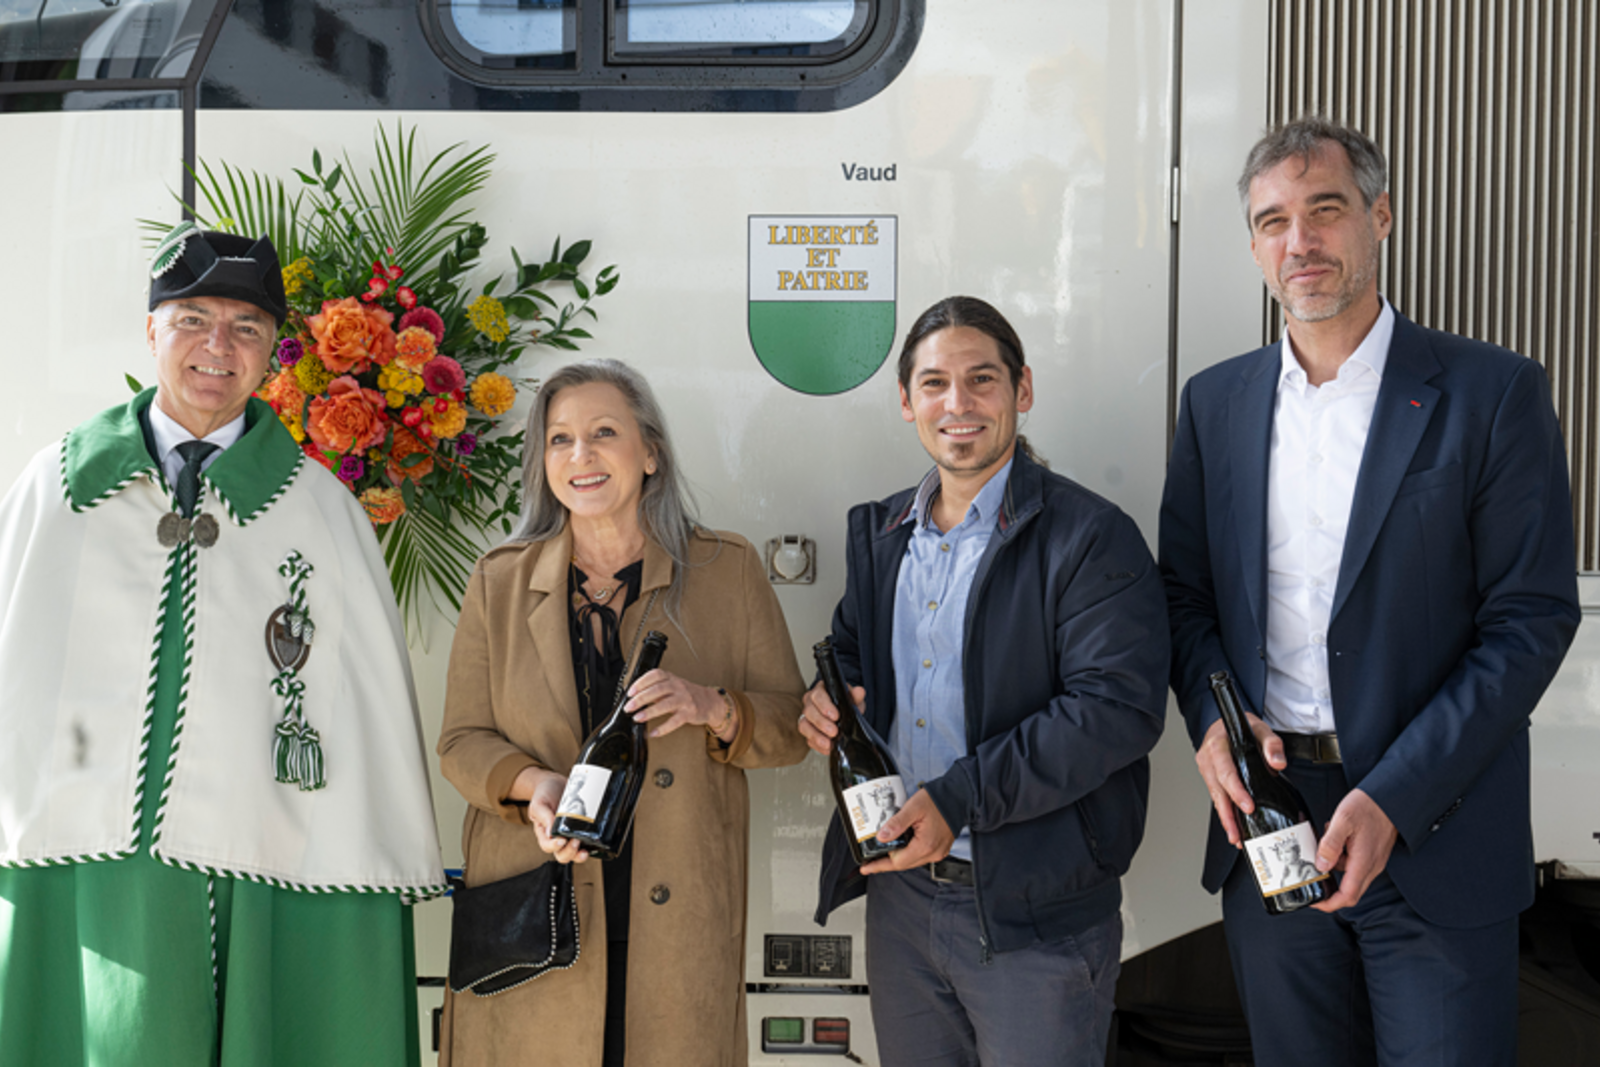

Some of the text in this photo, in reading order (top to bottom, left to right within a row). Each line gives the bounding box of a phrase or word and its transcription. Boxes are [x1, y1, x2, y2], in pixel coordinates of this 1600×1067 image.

[841, 162, 897, 181] Vaud
[767, 219, 879, 245] LIBERTÉ
[805, 248, 841, 268] ET
[777, 270, 869, 291] PATRIE
